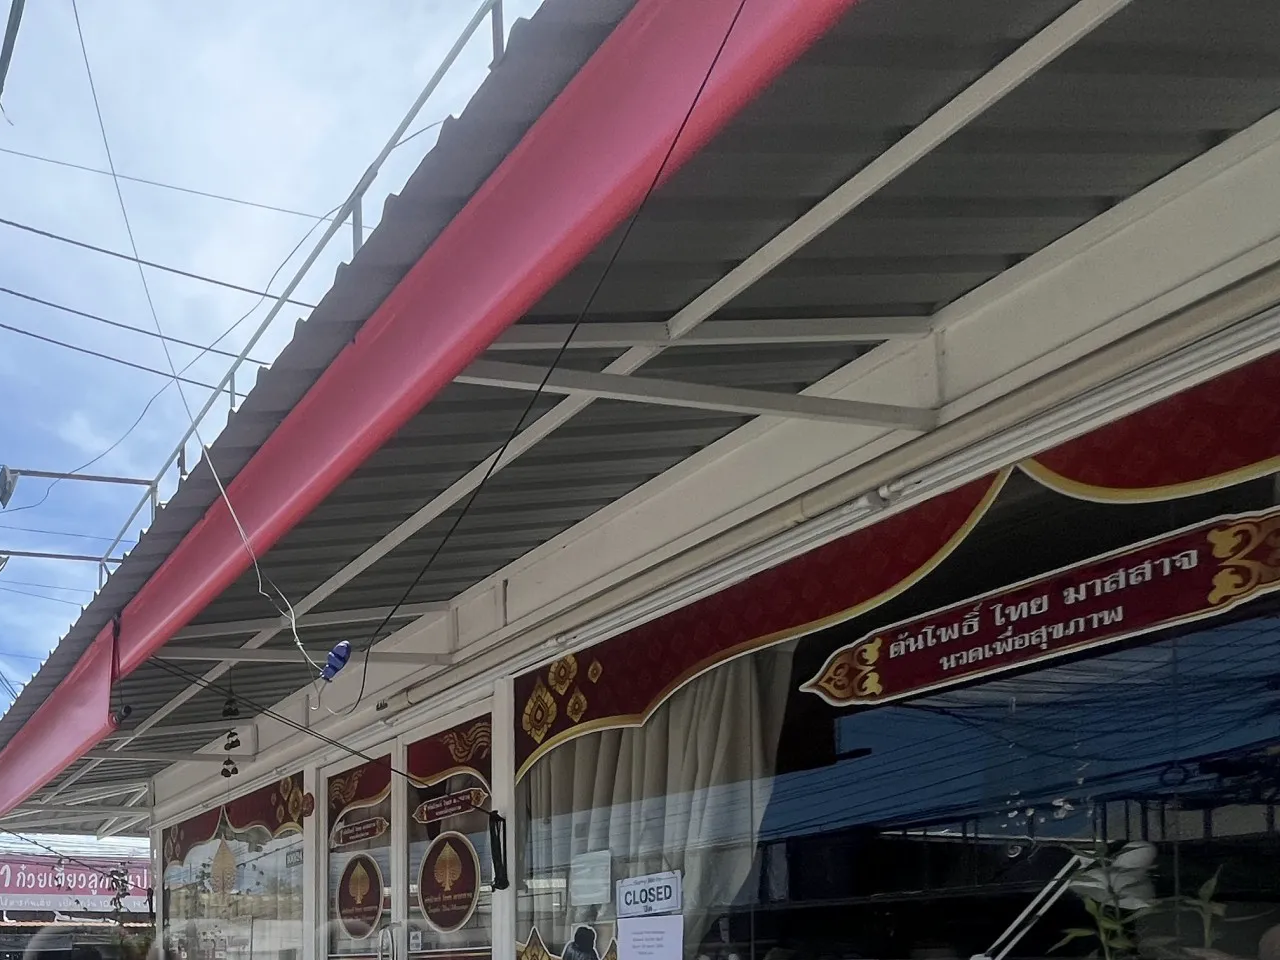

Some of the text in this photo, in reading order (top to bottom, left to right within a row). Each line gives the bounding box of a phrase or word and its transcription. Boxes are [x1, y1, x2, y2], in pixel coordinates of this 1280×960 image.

[889, 548, 1200, 659] ต้นโพธิ์ ไทย มาสสาจ
[939, 606, 1125, 671] นวดเพื่อสุขภาพ
[624, 885, 672, 906] CLOSED
